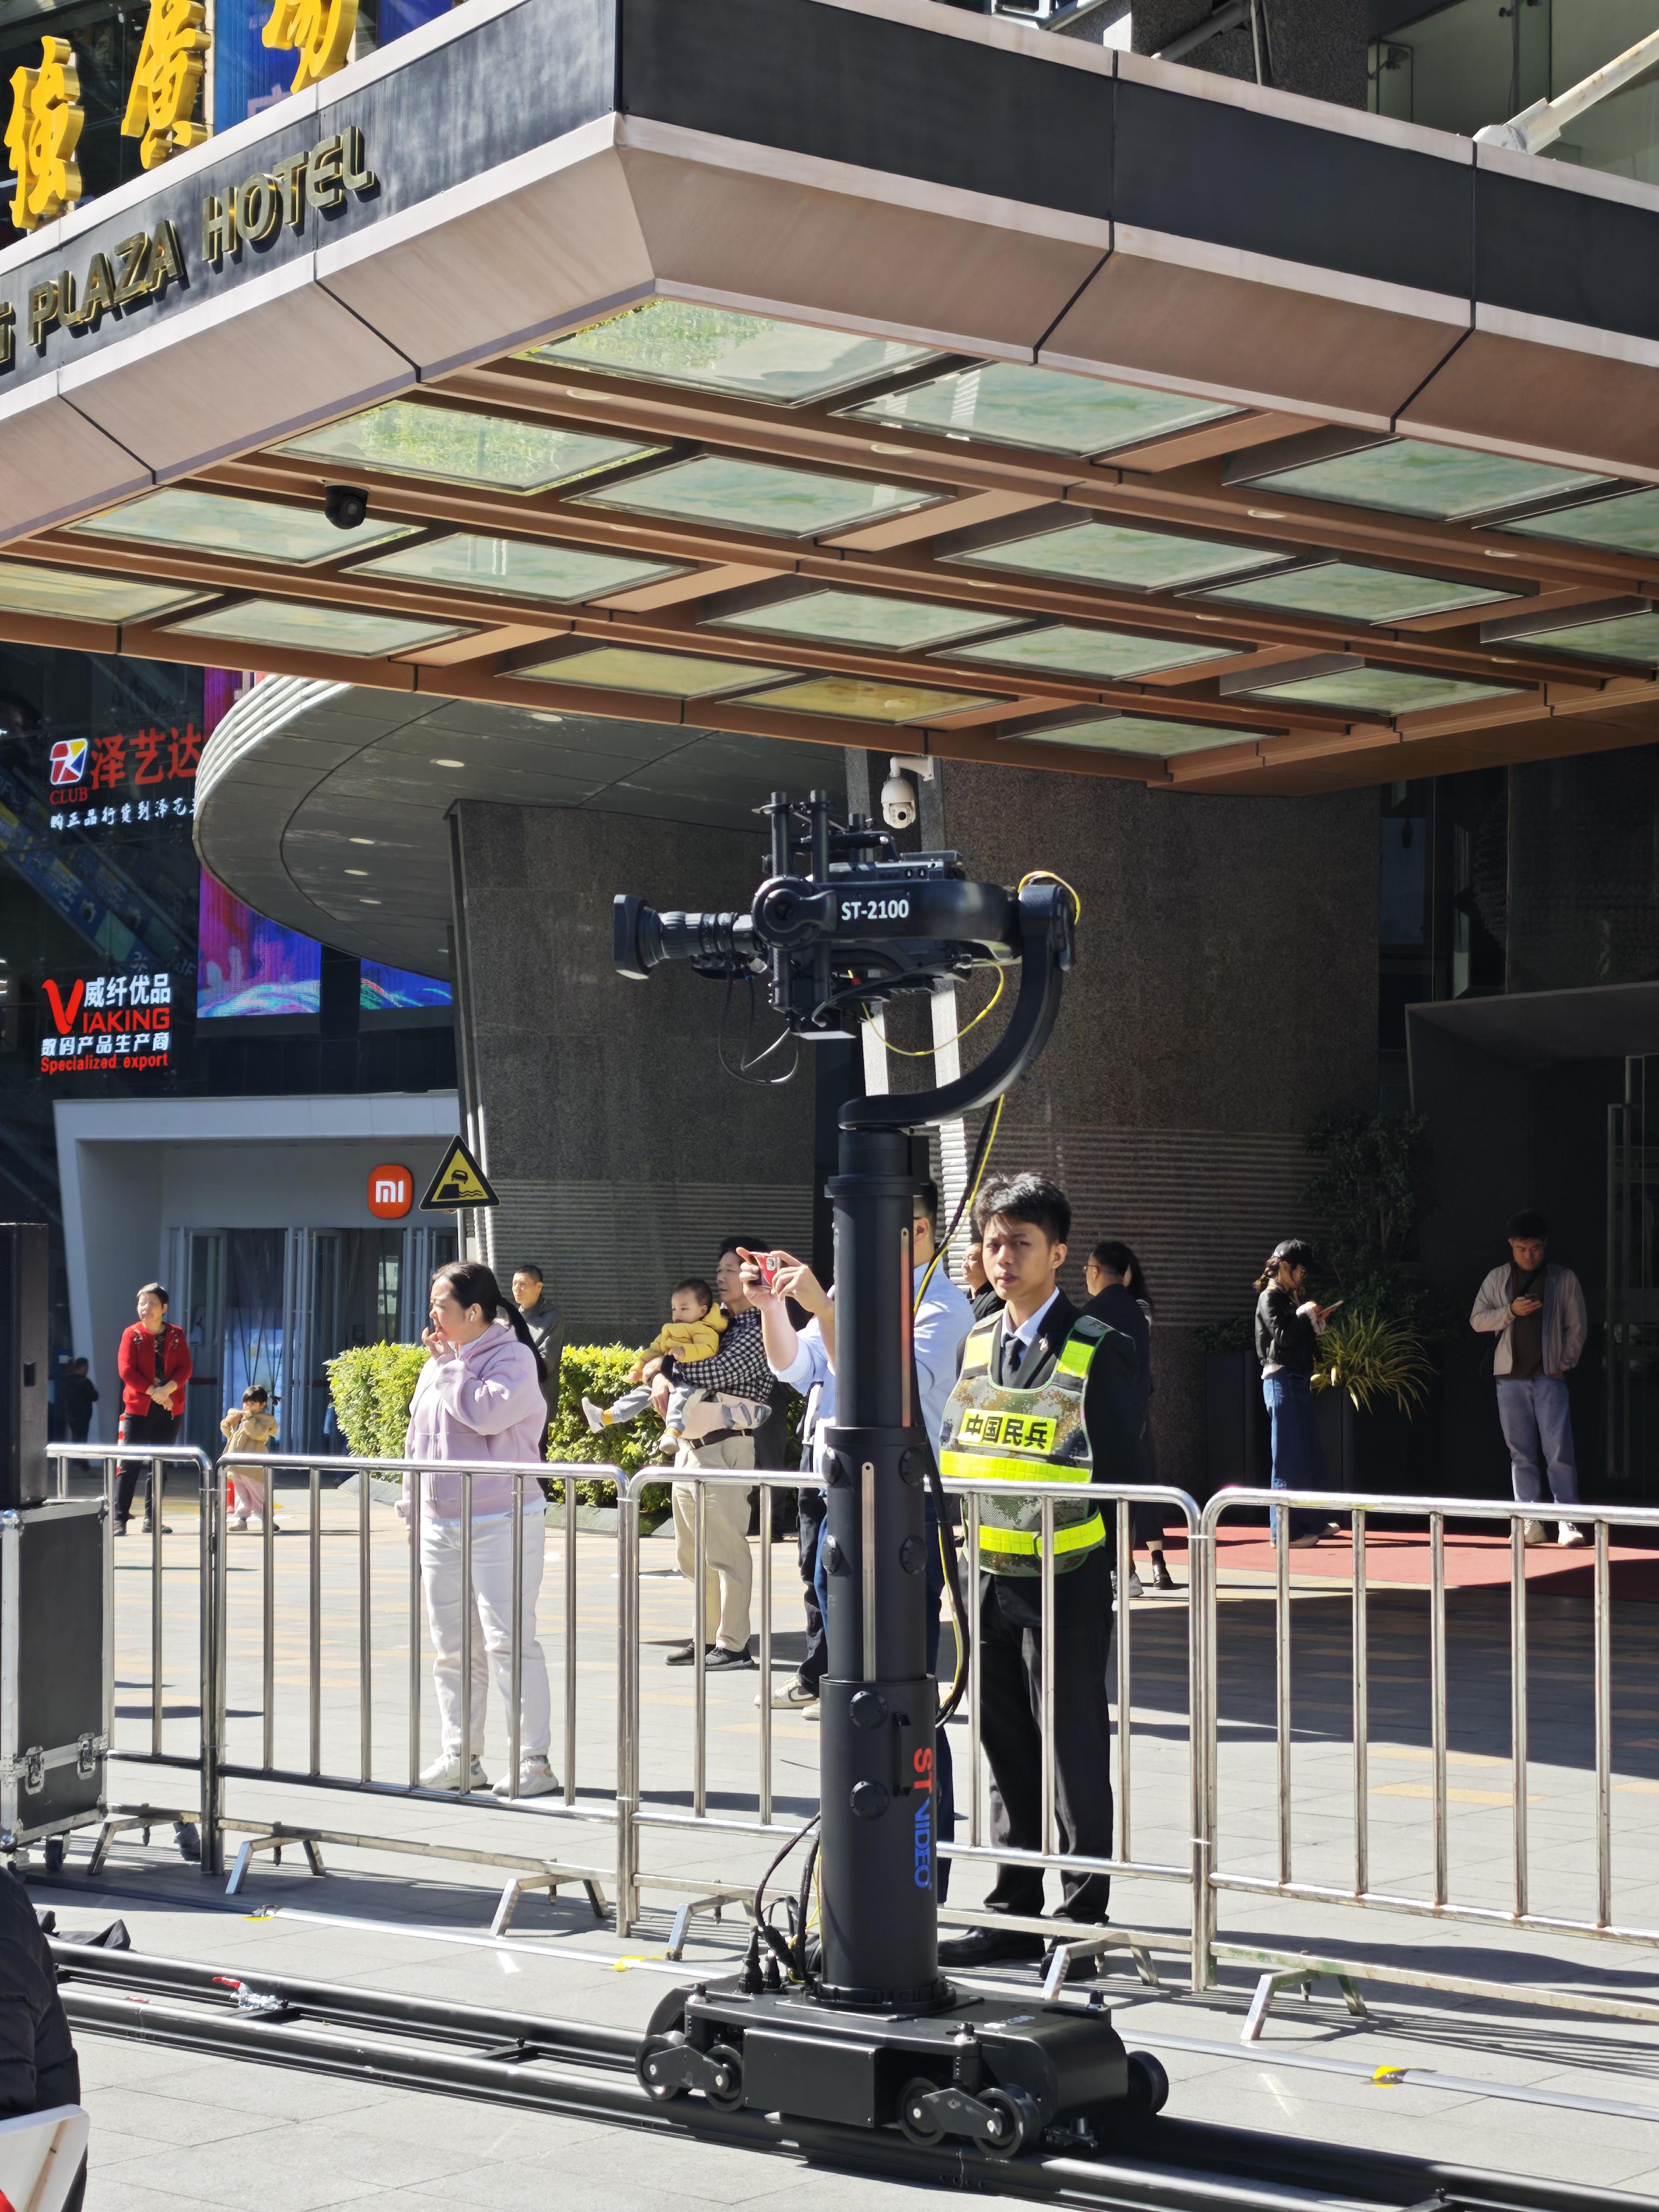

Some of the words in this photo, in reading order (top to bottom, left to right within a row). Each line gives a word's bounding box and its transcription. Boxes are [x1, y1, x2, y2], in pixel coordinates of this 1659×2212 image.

[27, 220, 185, 347] PLAZA
[202, 125, 376, 263] HOTEL
[90, 723, 201, 790] 泽艺达
[49, 786, 88, 805] CLUB
[841, 899, 909, 921] ST-2100
[84, 973, 171, 1008] 威纤优品
[41, 1031, 170, 1057] 数码产品生产商
[41, 1054, 117, 1075] Specialized
[123, 1053, 168, 1071] export
[965, 1413, 1048, 1450] 中国民兵
